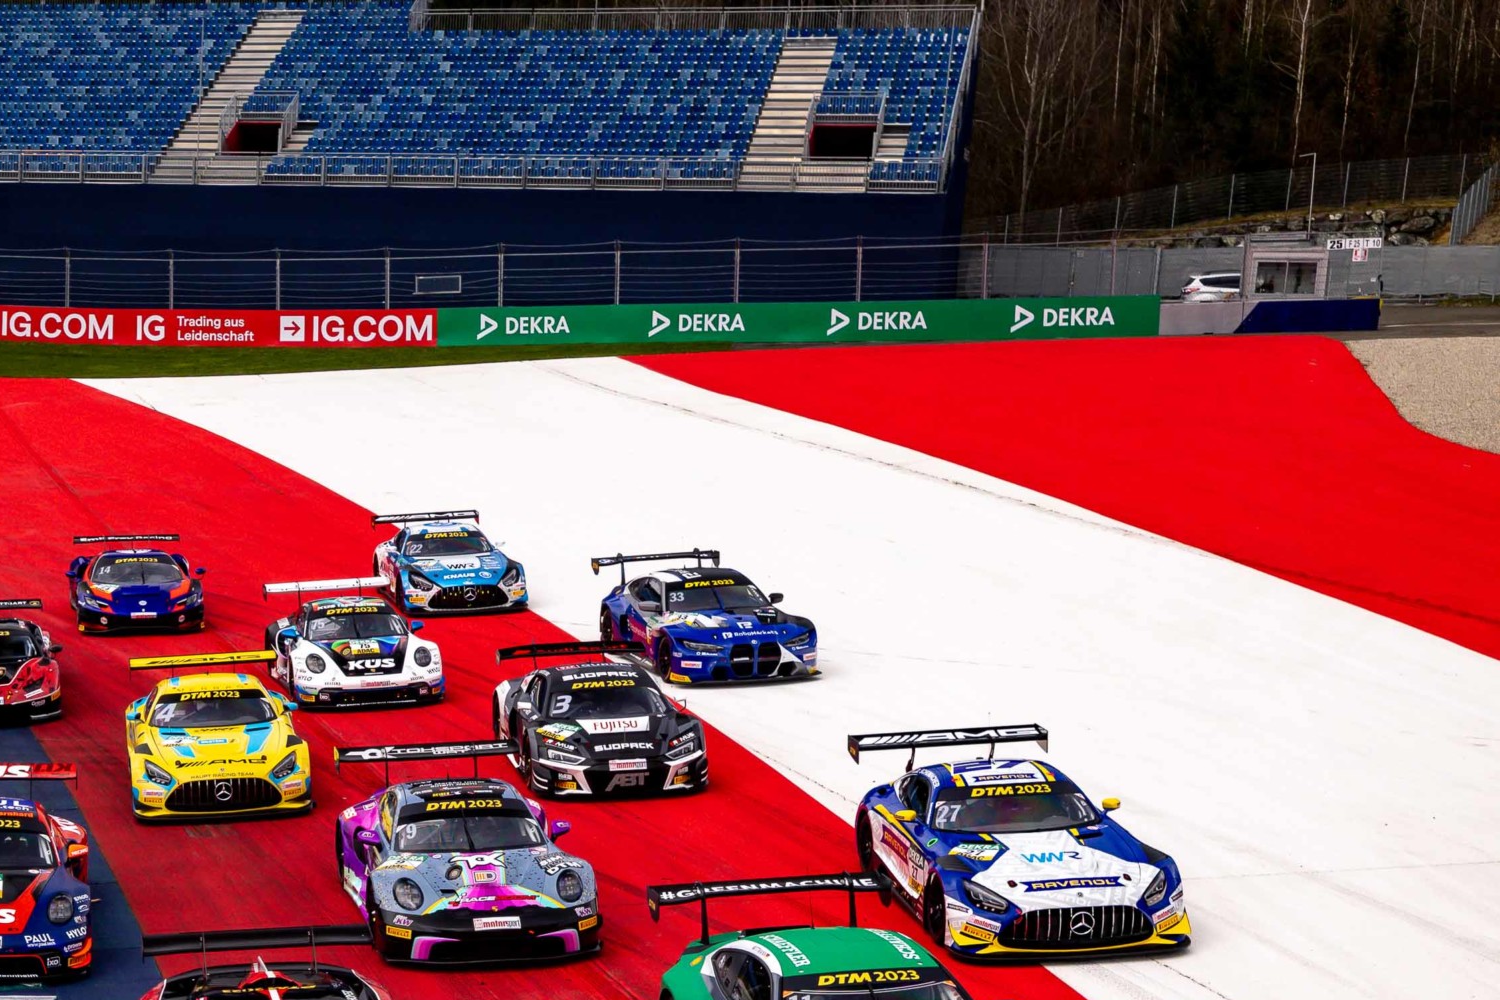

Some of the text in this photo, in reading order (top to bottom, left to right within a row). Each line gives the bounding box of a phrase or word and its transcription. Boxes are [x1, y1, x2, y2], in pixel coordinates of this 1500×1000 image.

[1330, 240, 1342, 249] 25
[177, 316, 244, 330] Trading aus
[678, 312, 745, 332] DEKRA
[858, 311, 927, 331] DEKRA
[1043, 308, 1115, 327] DEKRA
[2, 311, 113, 339] IG.COM
[136, 315, 164, 341] IG
[312, 315, 433, 342] IG.COM
[506, 315, 570, 335] DEKRA
[177, 330, 254, 343] Leidenschaft
[685, 580, 710, 588] DTM
[669, 593, 684, 602] 33
[326, 606, 378, 615] DTM 2023
[348, 658, 395, 670] KÜS
[571, 680, 605, 689] DTM
[180, 692, 211, 701] DTM
[553, 695, 572, 714] 3
[156, 703, 177, 722] 4
[594, 720, 637, 732] FUJITSU
[971, 784, 1051, 797] DTM 2023
[426, 799, 502, 811] DTM 2023
[936, 805, 960, 823] 27
[405, 824, 416, 839] 9
[1031, 878, 1114, 890] RAVENOL
[26, 933, 54, 943] PAUL
[817, 969, 920, 986] DTM 2023
